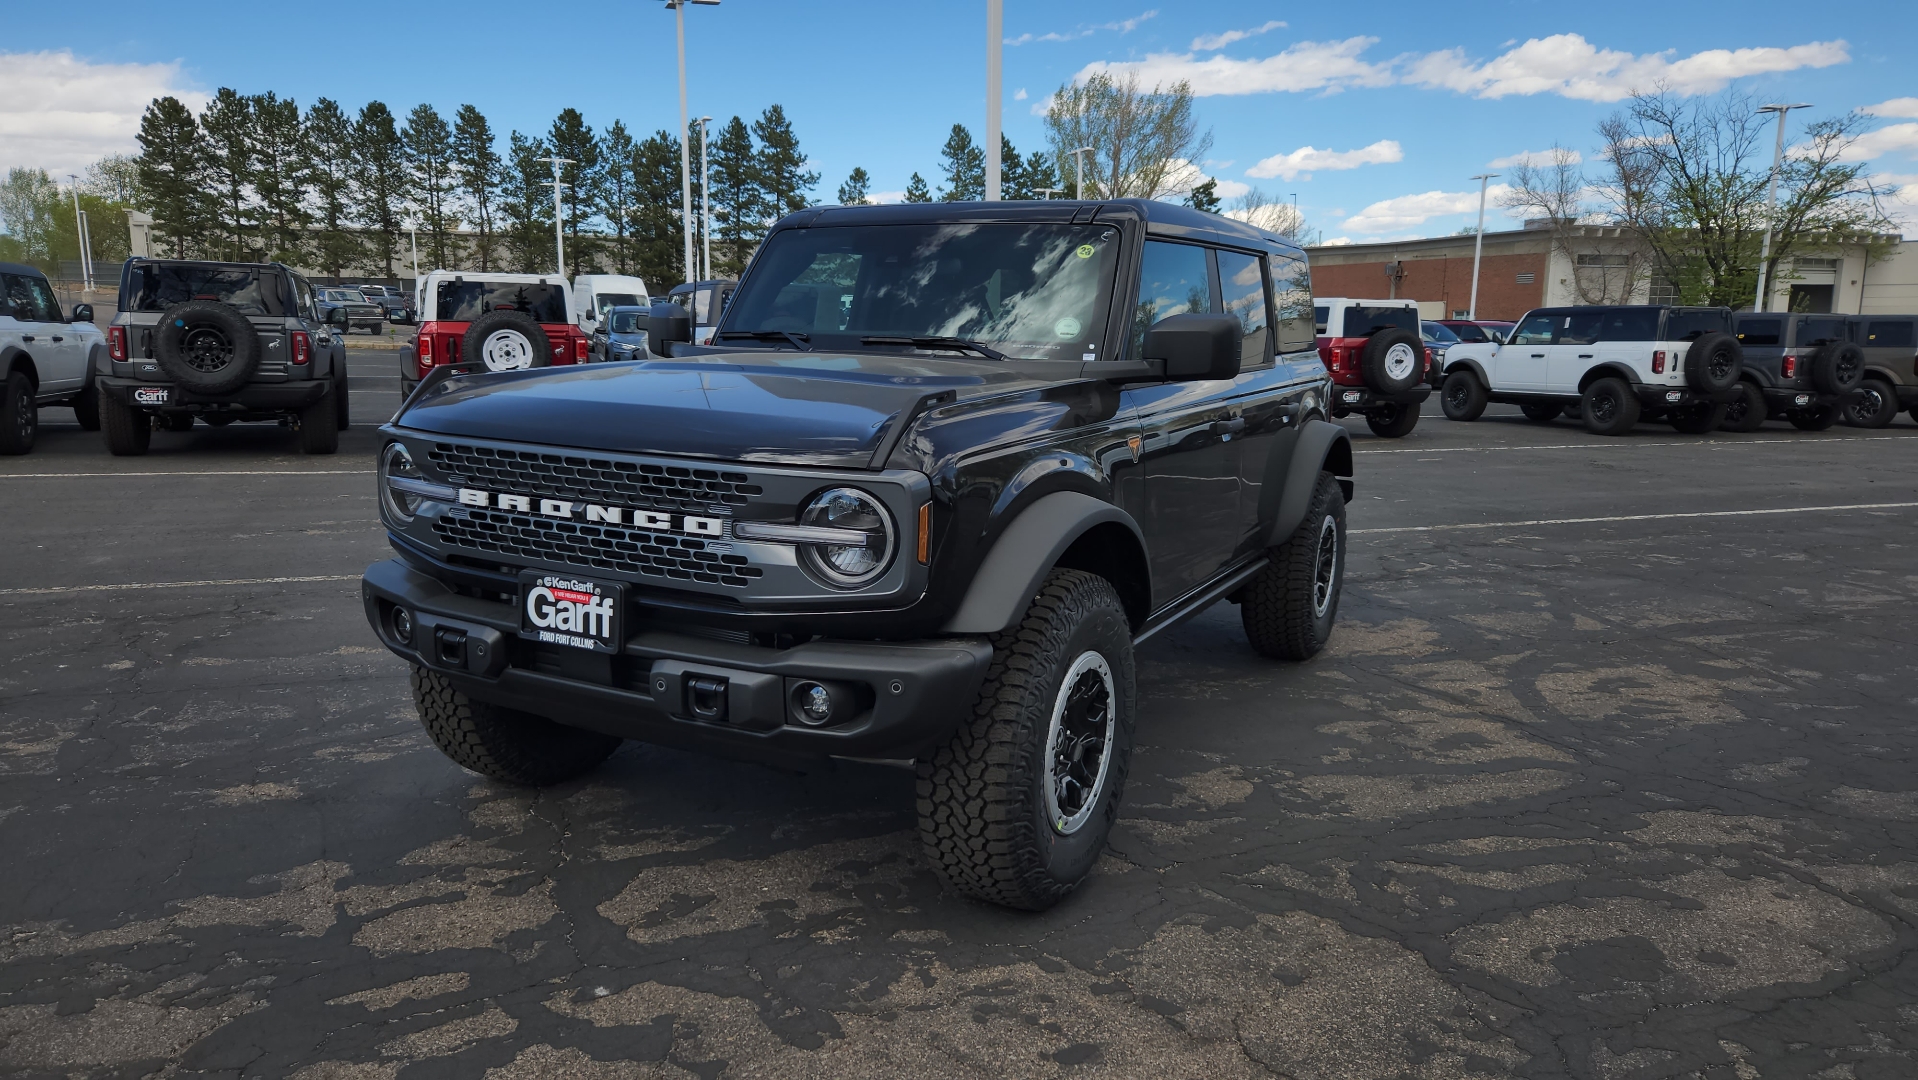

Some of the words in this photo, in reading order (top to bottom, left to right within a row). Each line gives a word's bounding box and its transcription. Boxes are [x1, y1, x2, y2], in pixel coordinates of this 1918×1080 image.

[1079, 246, 1092, 256] 23
[134, 389, 169, 401] Garff
[1342, 392, 1361, 401] Garff
[458, 487, 724, 536] BRONCO
[552, 576, 571, 590] Ken
[570, 579, 594, 594] Garff
[526, 586, 614, 638] Garff
[539, 630, 554, 642] FORD
[555, 633, 570, 645] FORT
[570, 636, 594, 650] COLLINS
